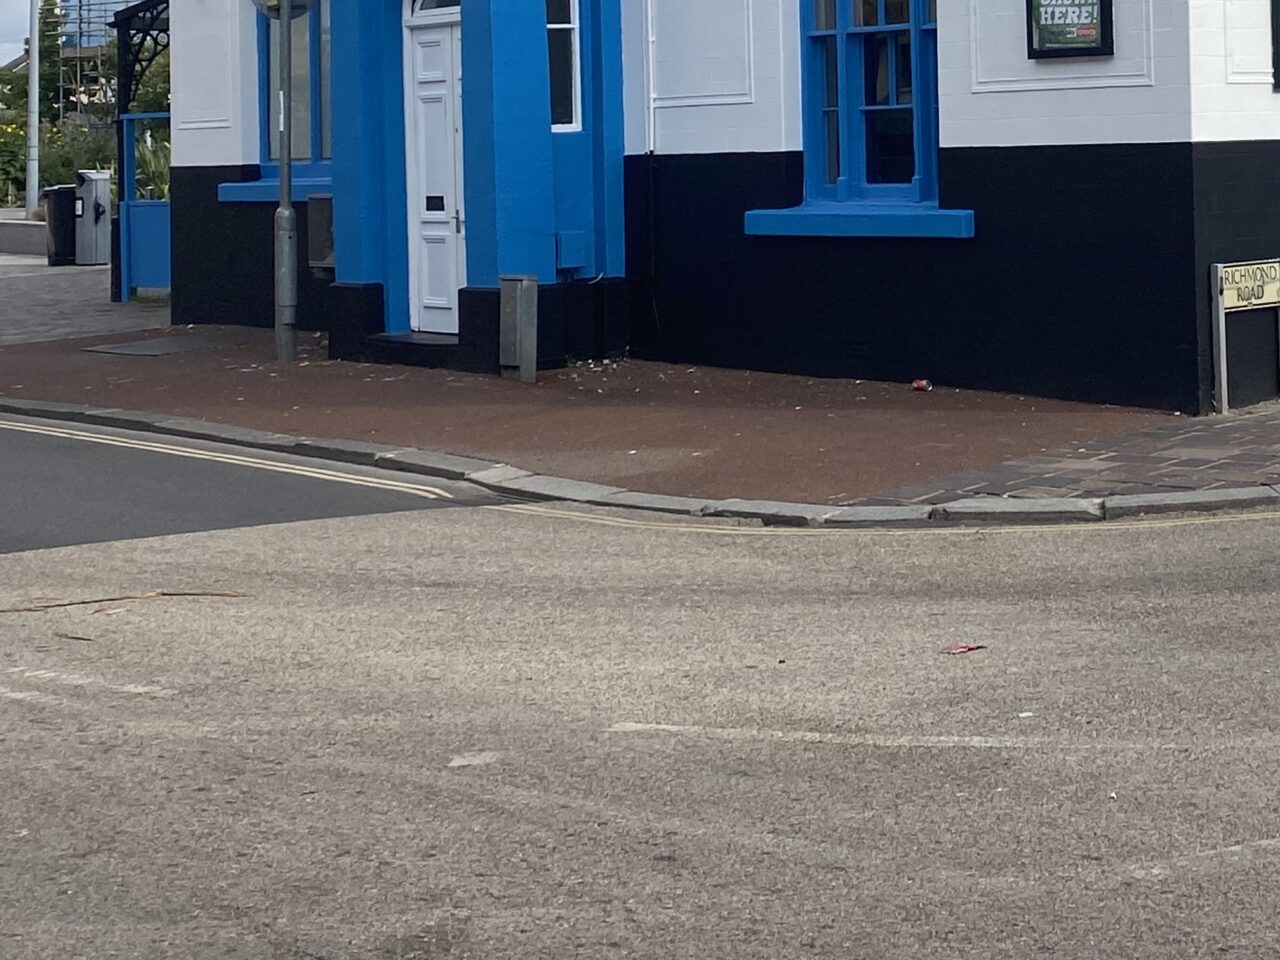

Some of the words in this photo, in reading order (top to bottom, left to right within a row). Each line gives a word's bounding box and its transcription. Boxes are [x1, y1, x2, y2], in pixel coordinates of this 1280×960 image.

[1040, 6, 1098, 25] HERE!
[1224, 265, 1277, 286] RICHMOND
[1236, 285, 1265, 303] ROAD
